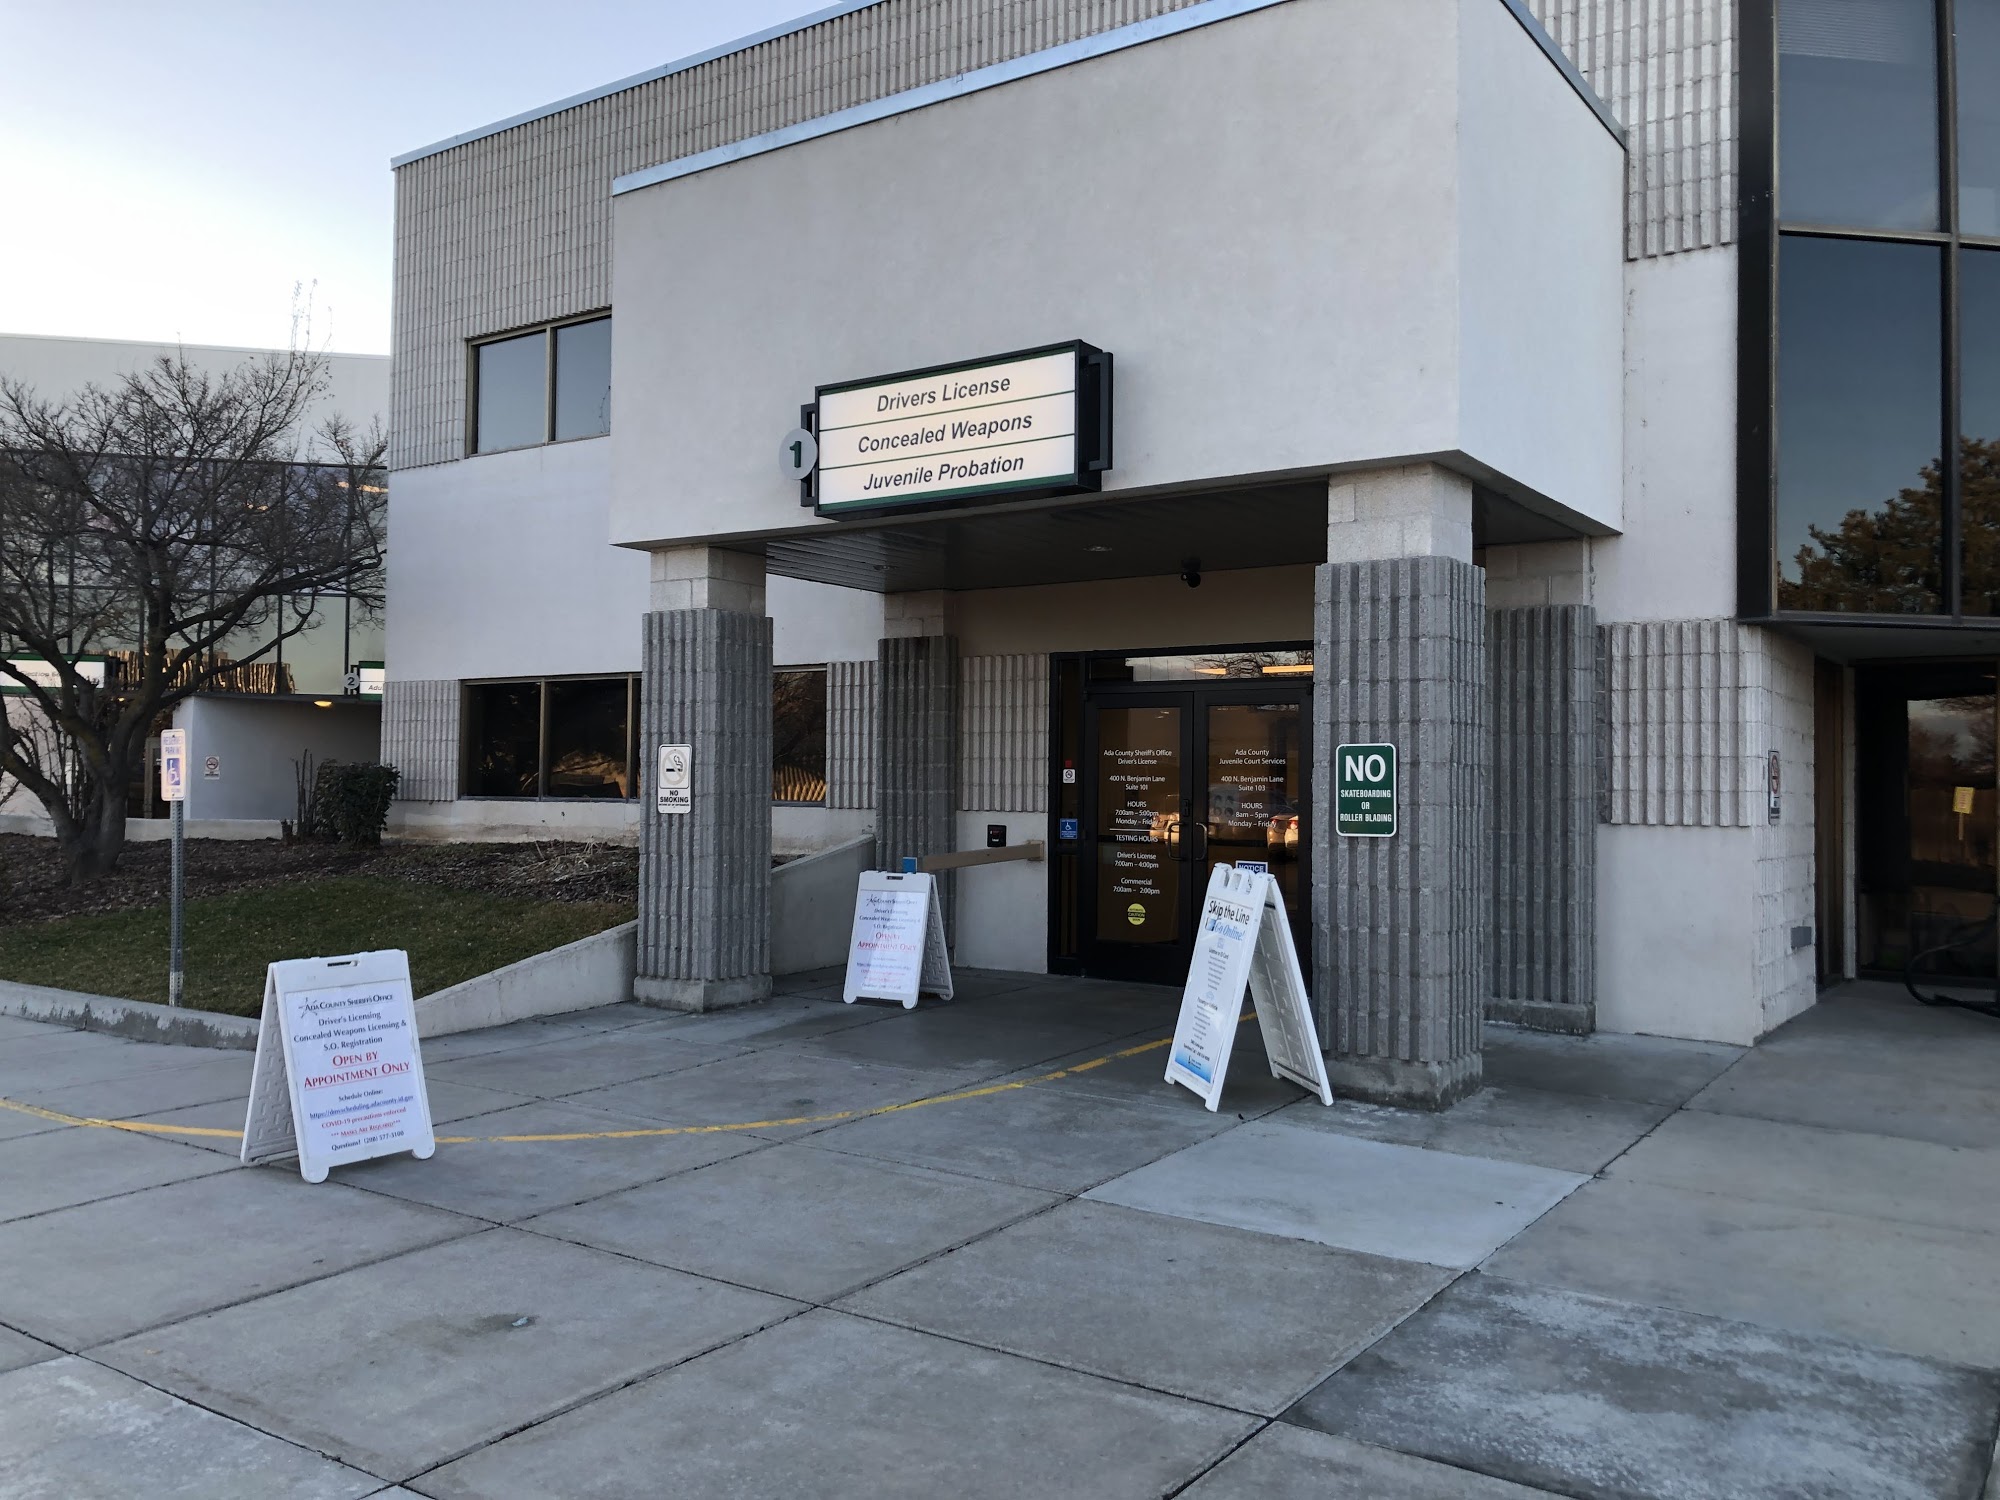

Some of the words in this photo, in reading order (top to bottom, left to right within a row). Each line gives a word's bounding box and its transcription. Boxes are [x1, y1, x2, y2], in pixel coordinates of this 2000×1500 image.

[876, 388, 936, 412] Drivers
[942, 377, 1010, 402] License
[858, 424, 945, 453] Concealed
[951, 414, 1032, 440] Weapons
[789, 440, 802, 468] 1
[863, 464, 933, 491] Juvenile
[938, 456, 1024, 480] Probation
[348, 676, 355, 686] 2
[1345, 754, 1386, 782] NO
[1340, 789, 1391, 798] SKATEBOARDING
[1365, 814, 1392, 822] BLADING
[1140, 887, 1160, 895] 2:00pm
[1209, 900, 1223, 917] Skip
[1224, 905, 1235, 920] the
[1235, 908, 1250, 925] Line
[1223, 924, 1246, 941] Online!
[320, 1001, 346, 1009] COUNTY
[347, 996, 373, 1005] SHERIFF'S
[373, 994, 393, 1002] OFFICE
[318, 1016, 346, 1026] Driver's
[349, 1011, 381, 1022] Licensing
[294, 1030, 331, 1042] Concealed
[333, 1027, 366, 1037] Weapons
[368, 1021, 400, 1031] Licensing
[324, 1042, 339, 1051] S.O.
[341, 1036, 383, 1049] Registration
[332, 1053, 363, 1067] OPEN
[366, 1051, 378, 1062] BY
[304, 1067, 378, 1088] APPOINTMENT
[381, 1062, 410, 1075] ONLY
[338, 1093, 362, 1102] Schedule
[321, 1119, 351, 1128] COVID-19
[352, 1113, 382, 1124] precautions
[383, 1106, 406, 1115] enforced
